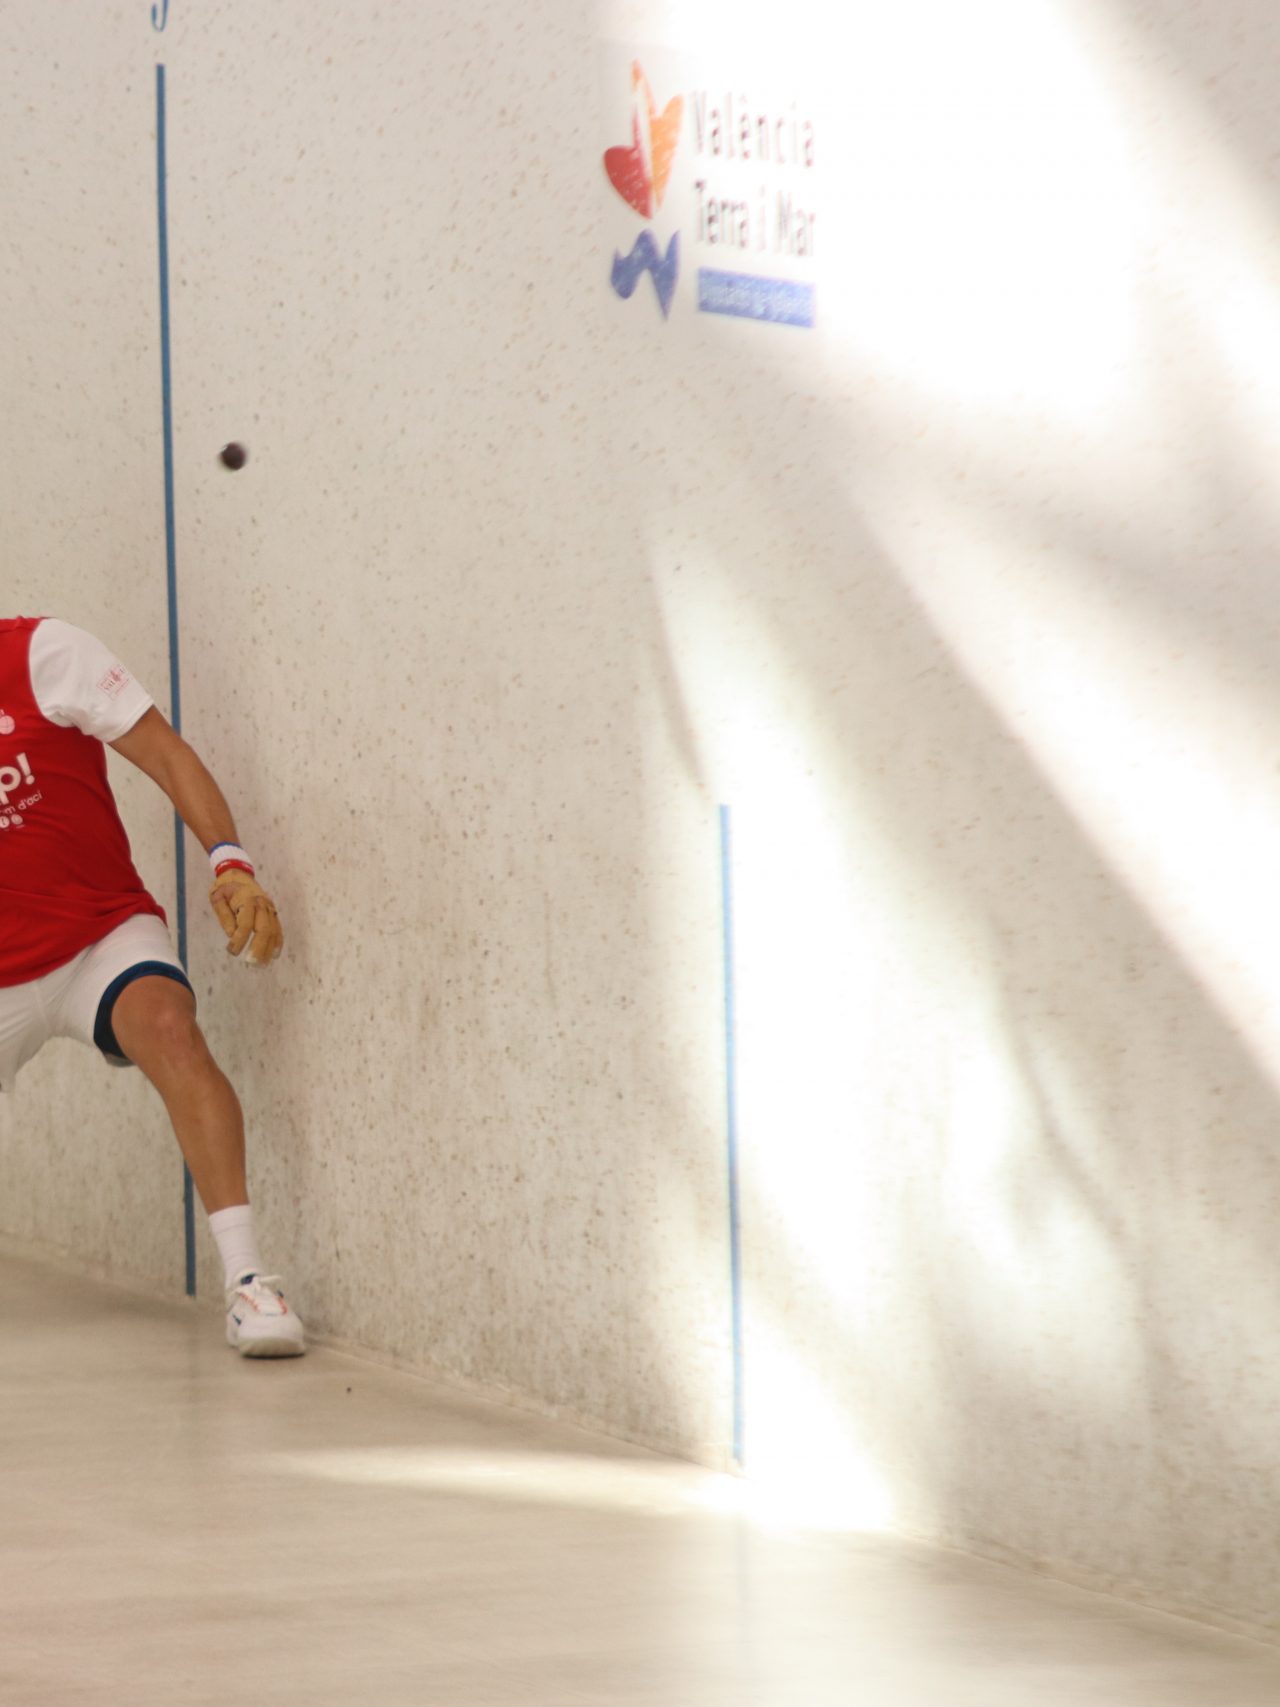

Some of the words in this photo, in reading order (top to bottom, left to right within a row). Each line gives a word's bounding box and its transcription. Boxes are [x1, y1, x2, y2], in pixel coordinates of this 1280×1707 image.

[694, 90, 814, 168] València
[693, 179, 748, 249] Terra
[757, 186, 766, 252] i
[773, 189, 816, 257] Mar
